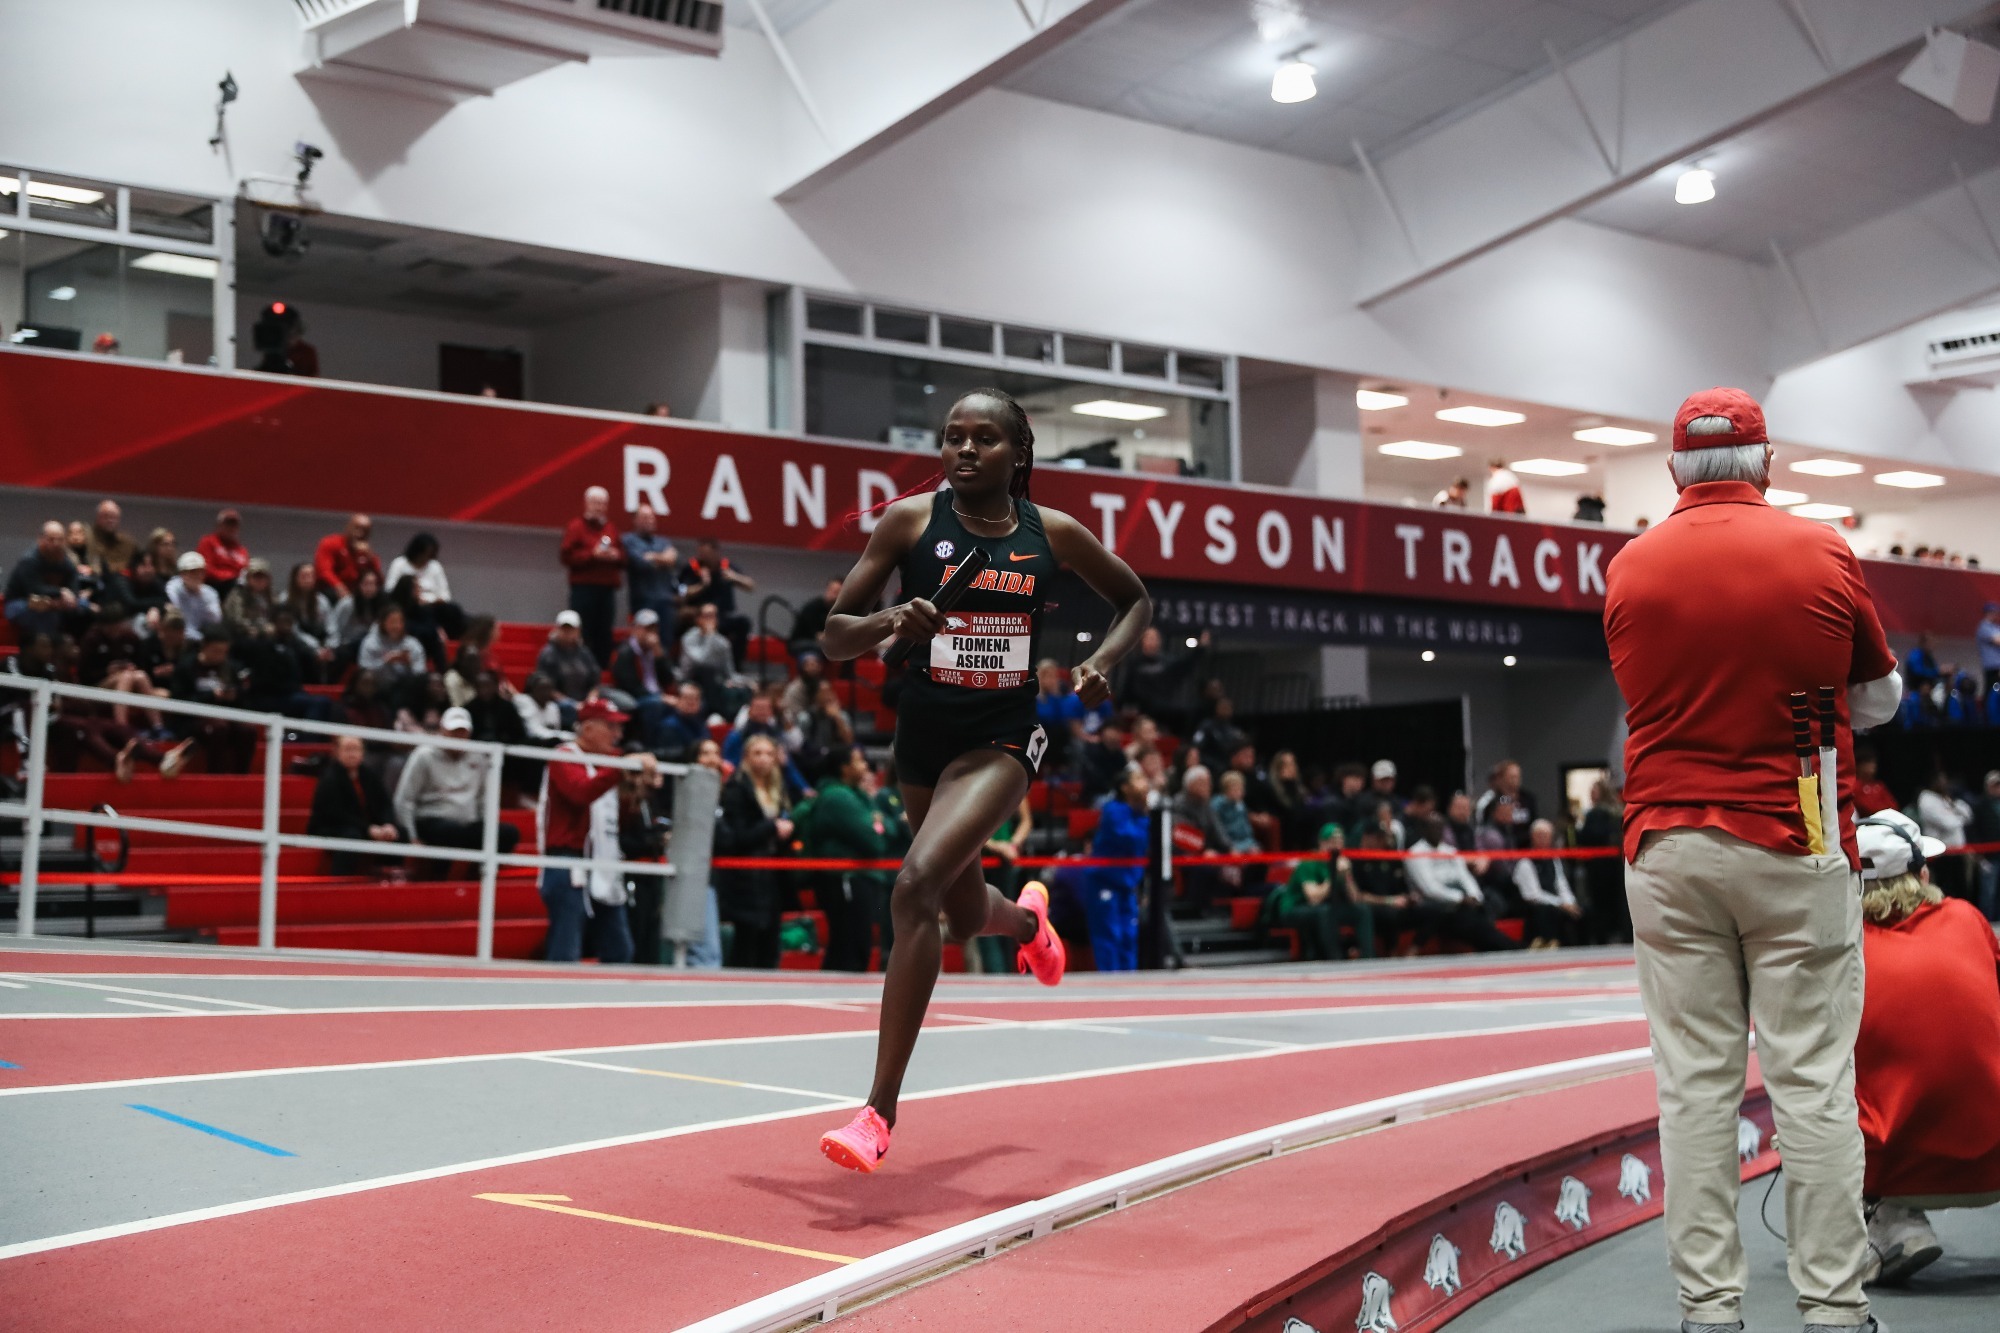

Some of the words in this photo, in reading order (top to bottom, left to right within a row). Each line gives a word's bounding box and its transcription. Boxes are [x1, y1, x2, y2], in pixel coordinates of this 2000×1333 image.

[623, 444, 952, 534] RAND
[1090, 492, 1346, 574] TYSON
[1395, 523, 1607, 597] TRACK
[936, 541, 954, 559] SEC
[939, 565, 1036, 596] FRIDA
[973, 616, 1022, 625] RAZORBACK
[1158, 600, 1256, 627] STEST
[1268, 605, 1349, 634] TRACK
[1358, 613, 1384, 637] IN
[1395, 614, 1438, 641] THE
[1449, 618, 1523, 646] WORLD
[972, 625, 1029, 634] INVITATIONAL
[952, 637, 1010, 653] FLOMENA
[956, 654, 1005, 669] ASEKOL
